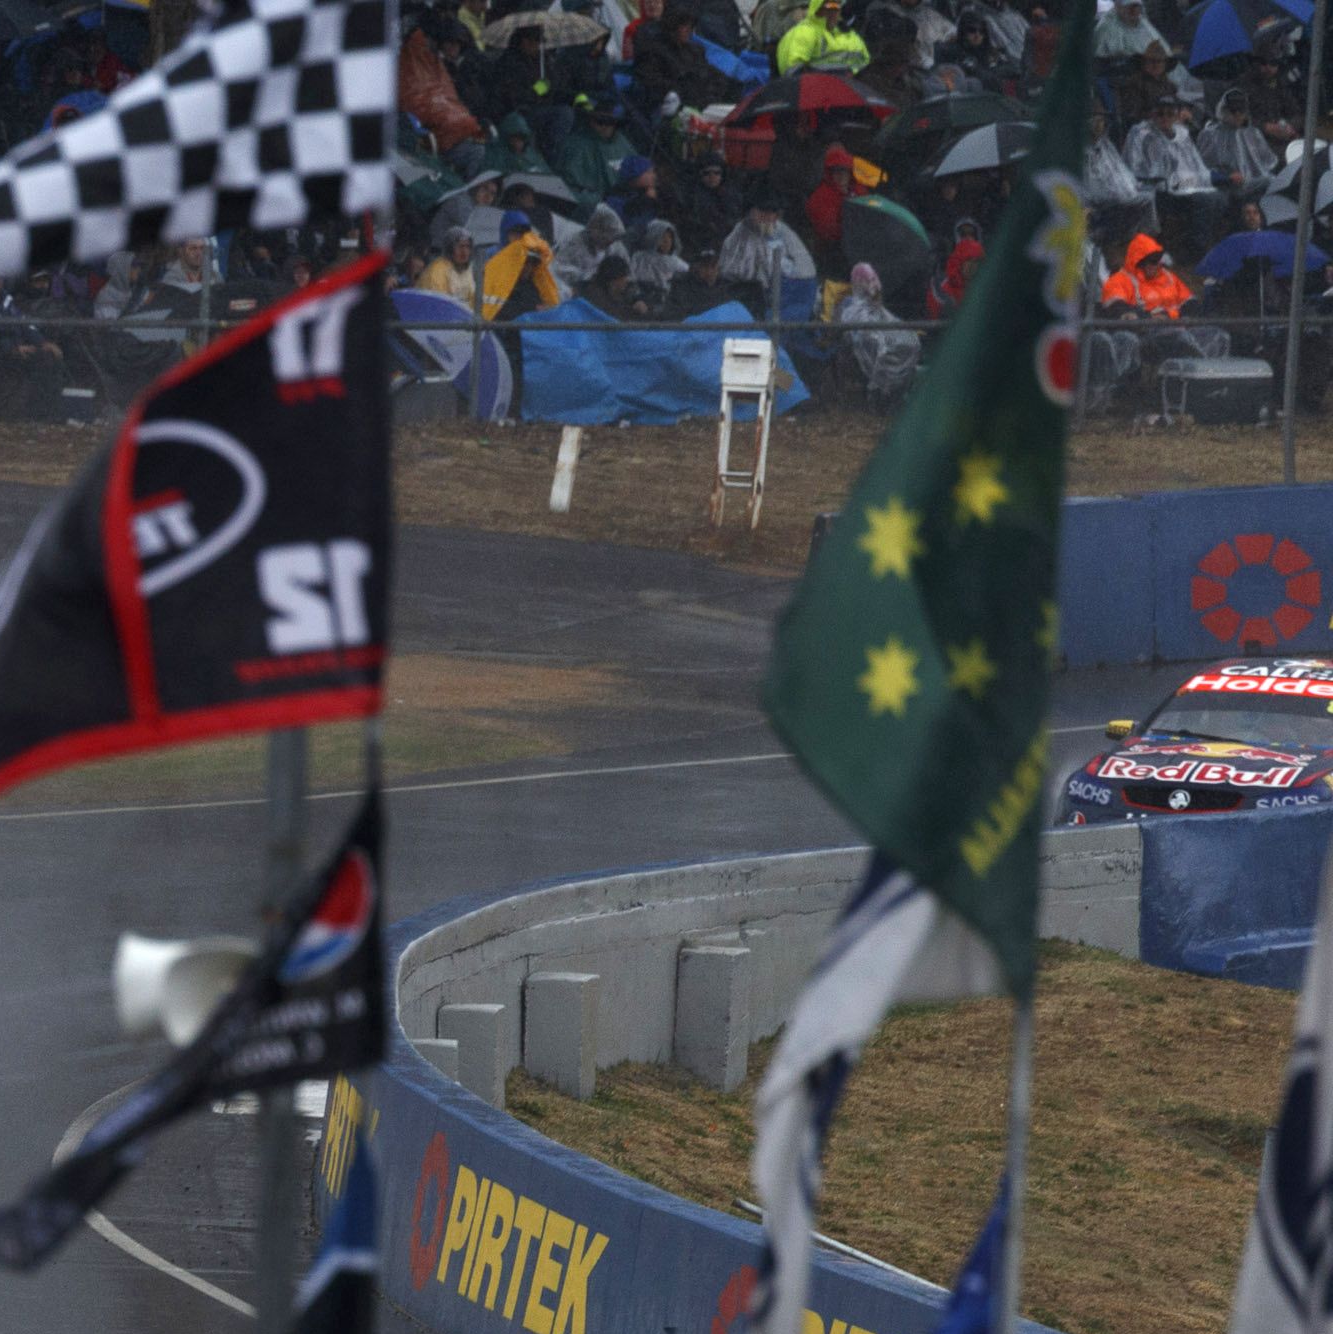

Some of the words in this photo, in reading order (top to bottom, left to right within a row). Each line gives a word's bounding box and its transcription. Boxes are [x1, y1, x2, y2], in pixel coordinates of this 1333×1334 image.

[1098, 756, 1197, 782] Red
[1190, 761, 1304, 787] Bull
[1068, 780, 1112, 805] SACHS
